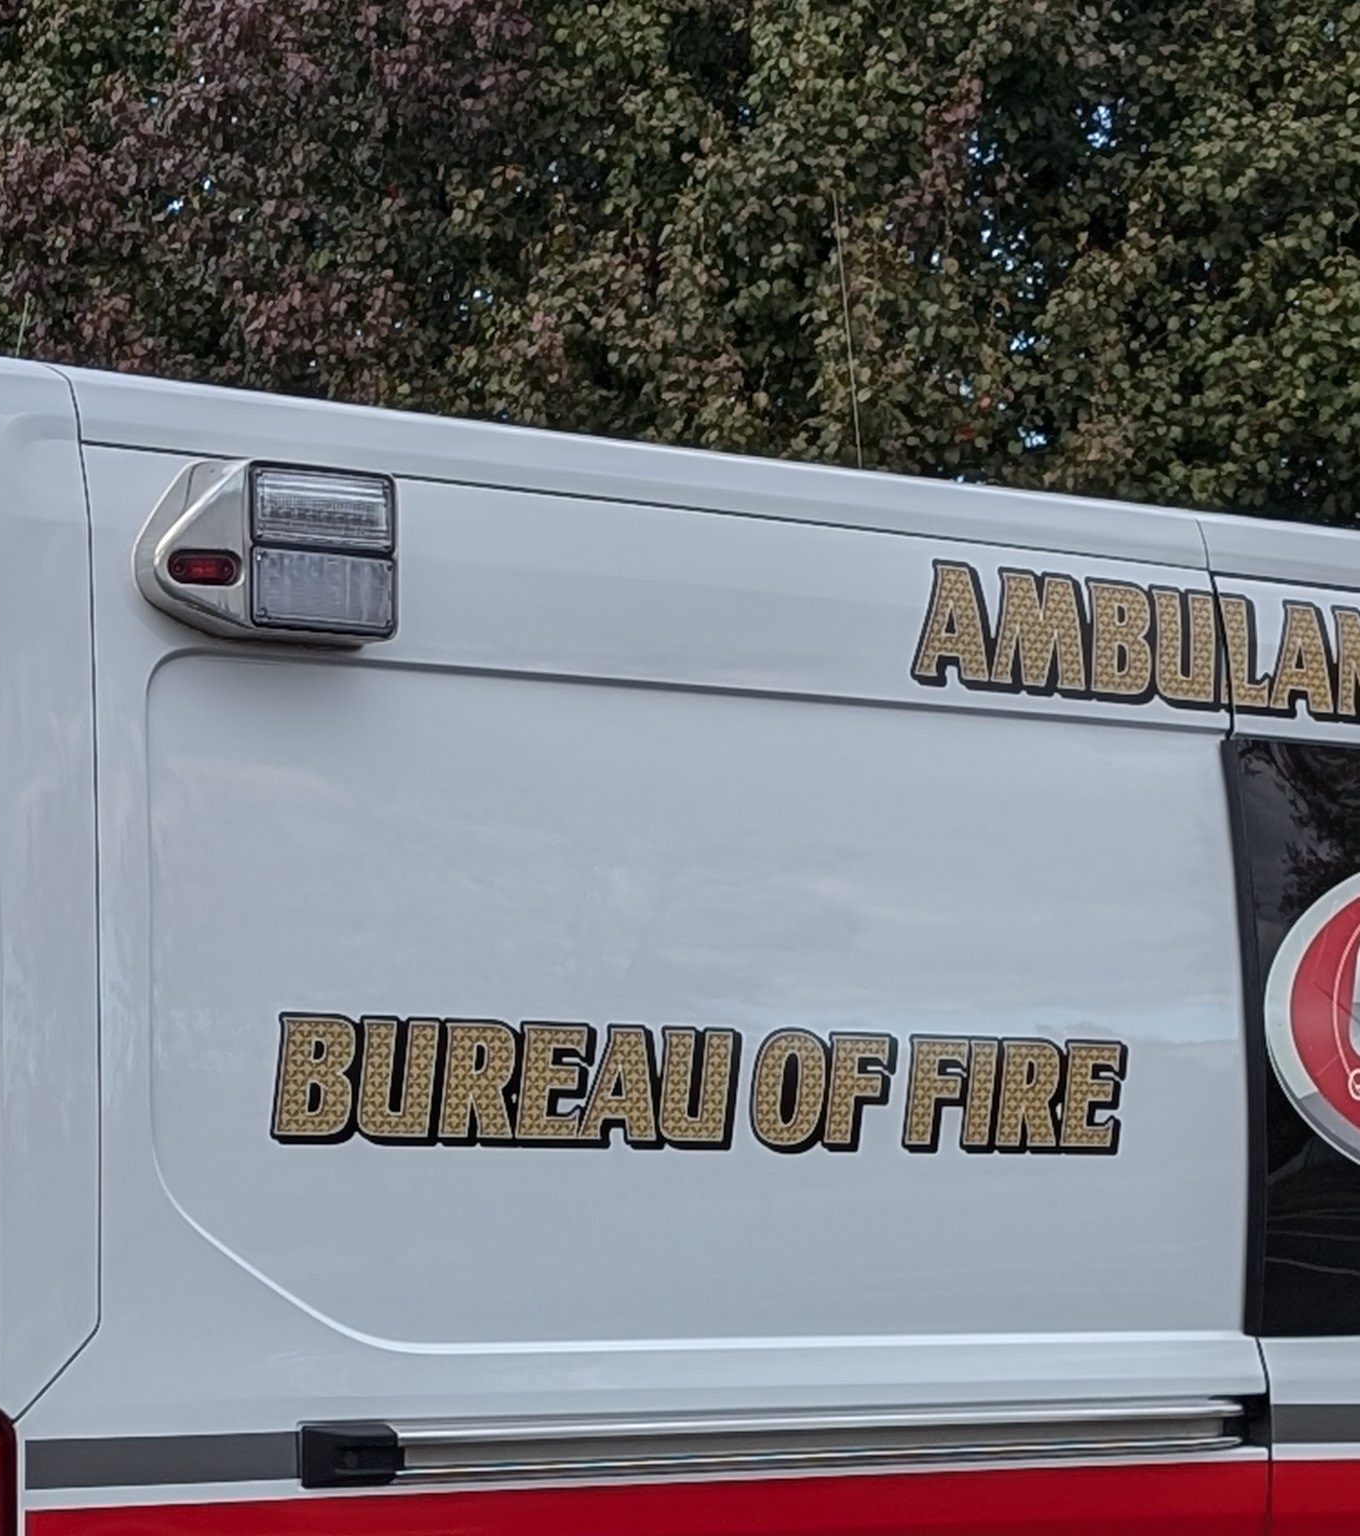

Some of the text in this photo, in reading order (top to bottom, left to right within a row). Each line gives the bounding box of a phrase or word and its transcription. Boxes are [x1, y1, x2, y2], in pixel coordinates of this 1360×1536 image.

[271, 1012, 1126, 1154] BUREAU OF FIRE
